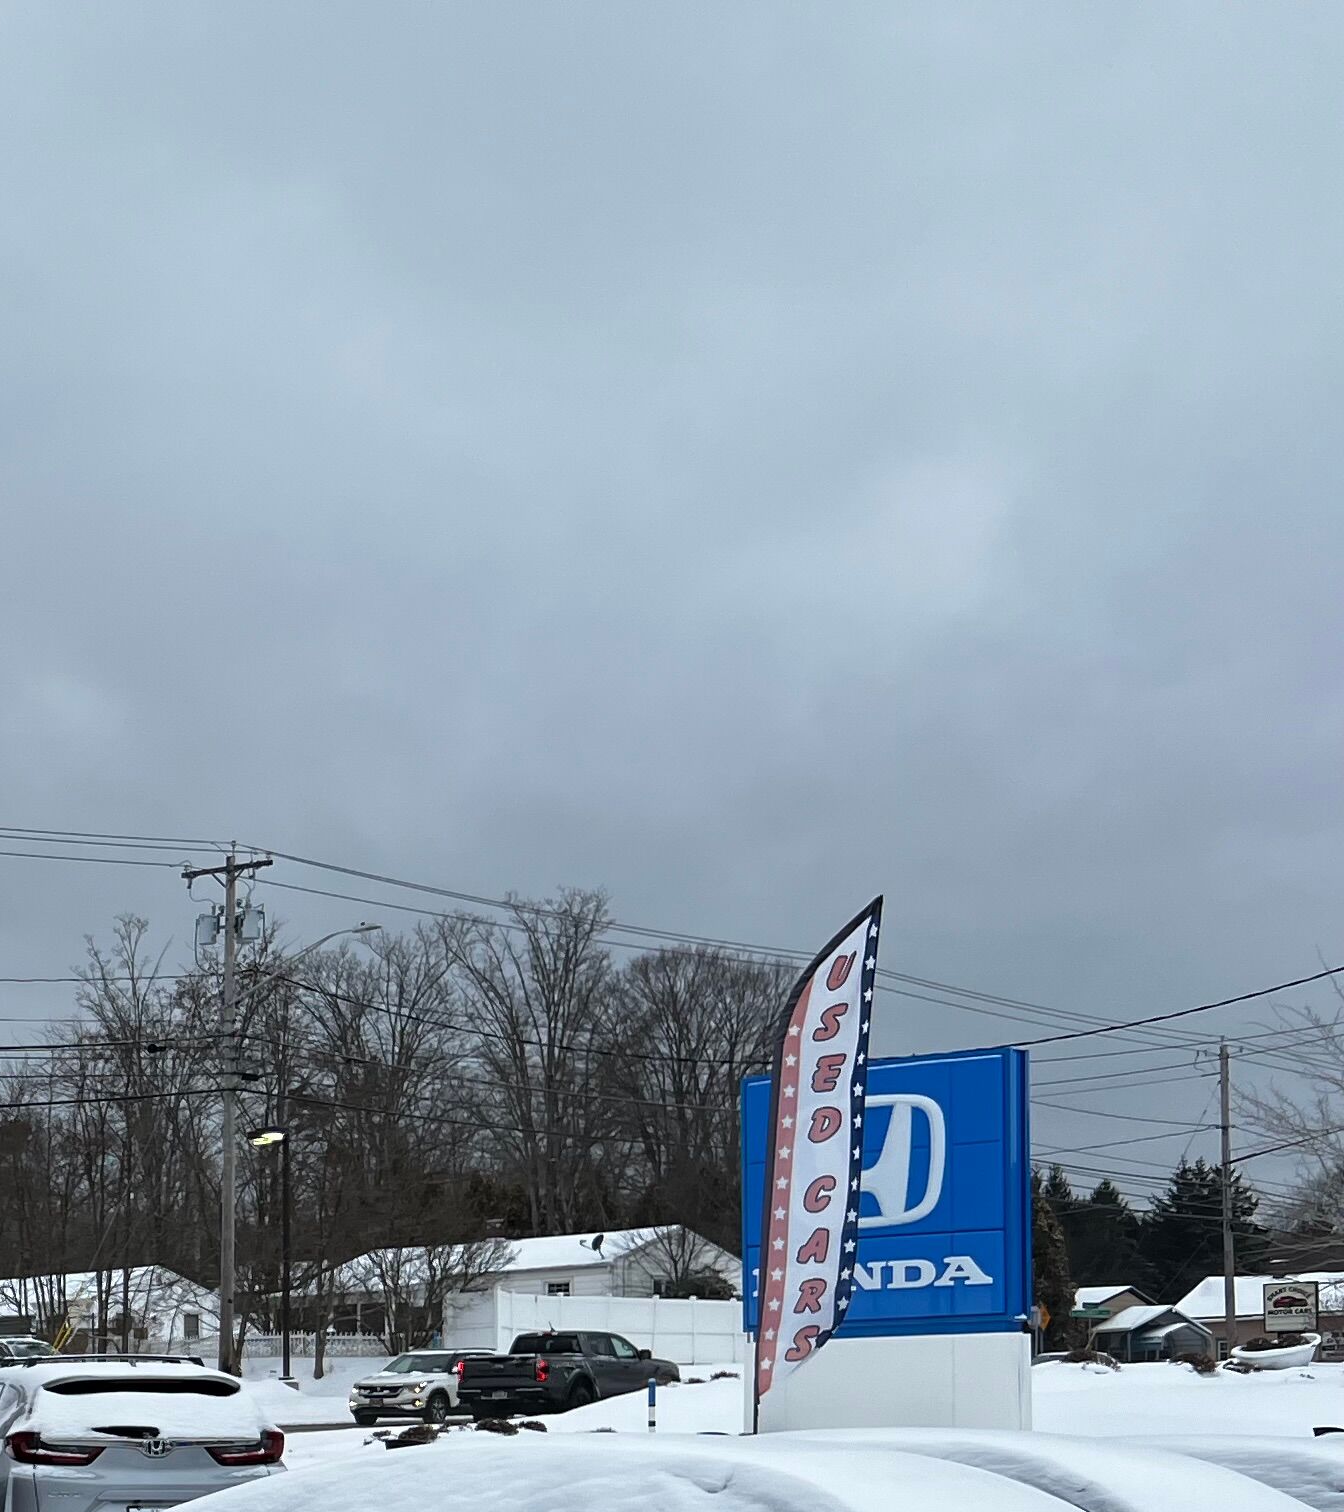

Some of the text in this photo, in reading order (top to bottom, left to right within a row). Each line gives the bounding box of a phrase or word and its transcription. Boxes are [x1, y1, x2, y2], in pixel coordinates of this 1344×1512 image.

[785, 950, 857, 1363] USED CARS
[752, 1255, 994, 1299] NDA
